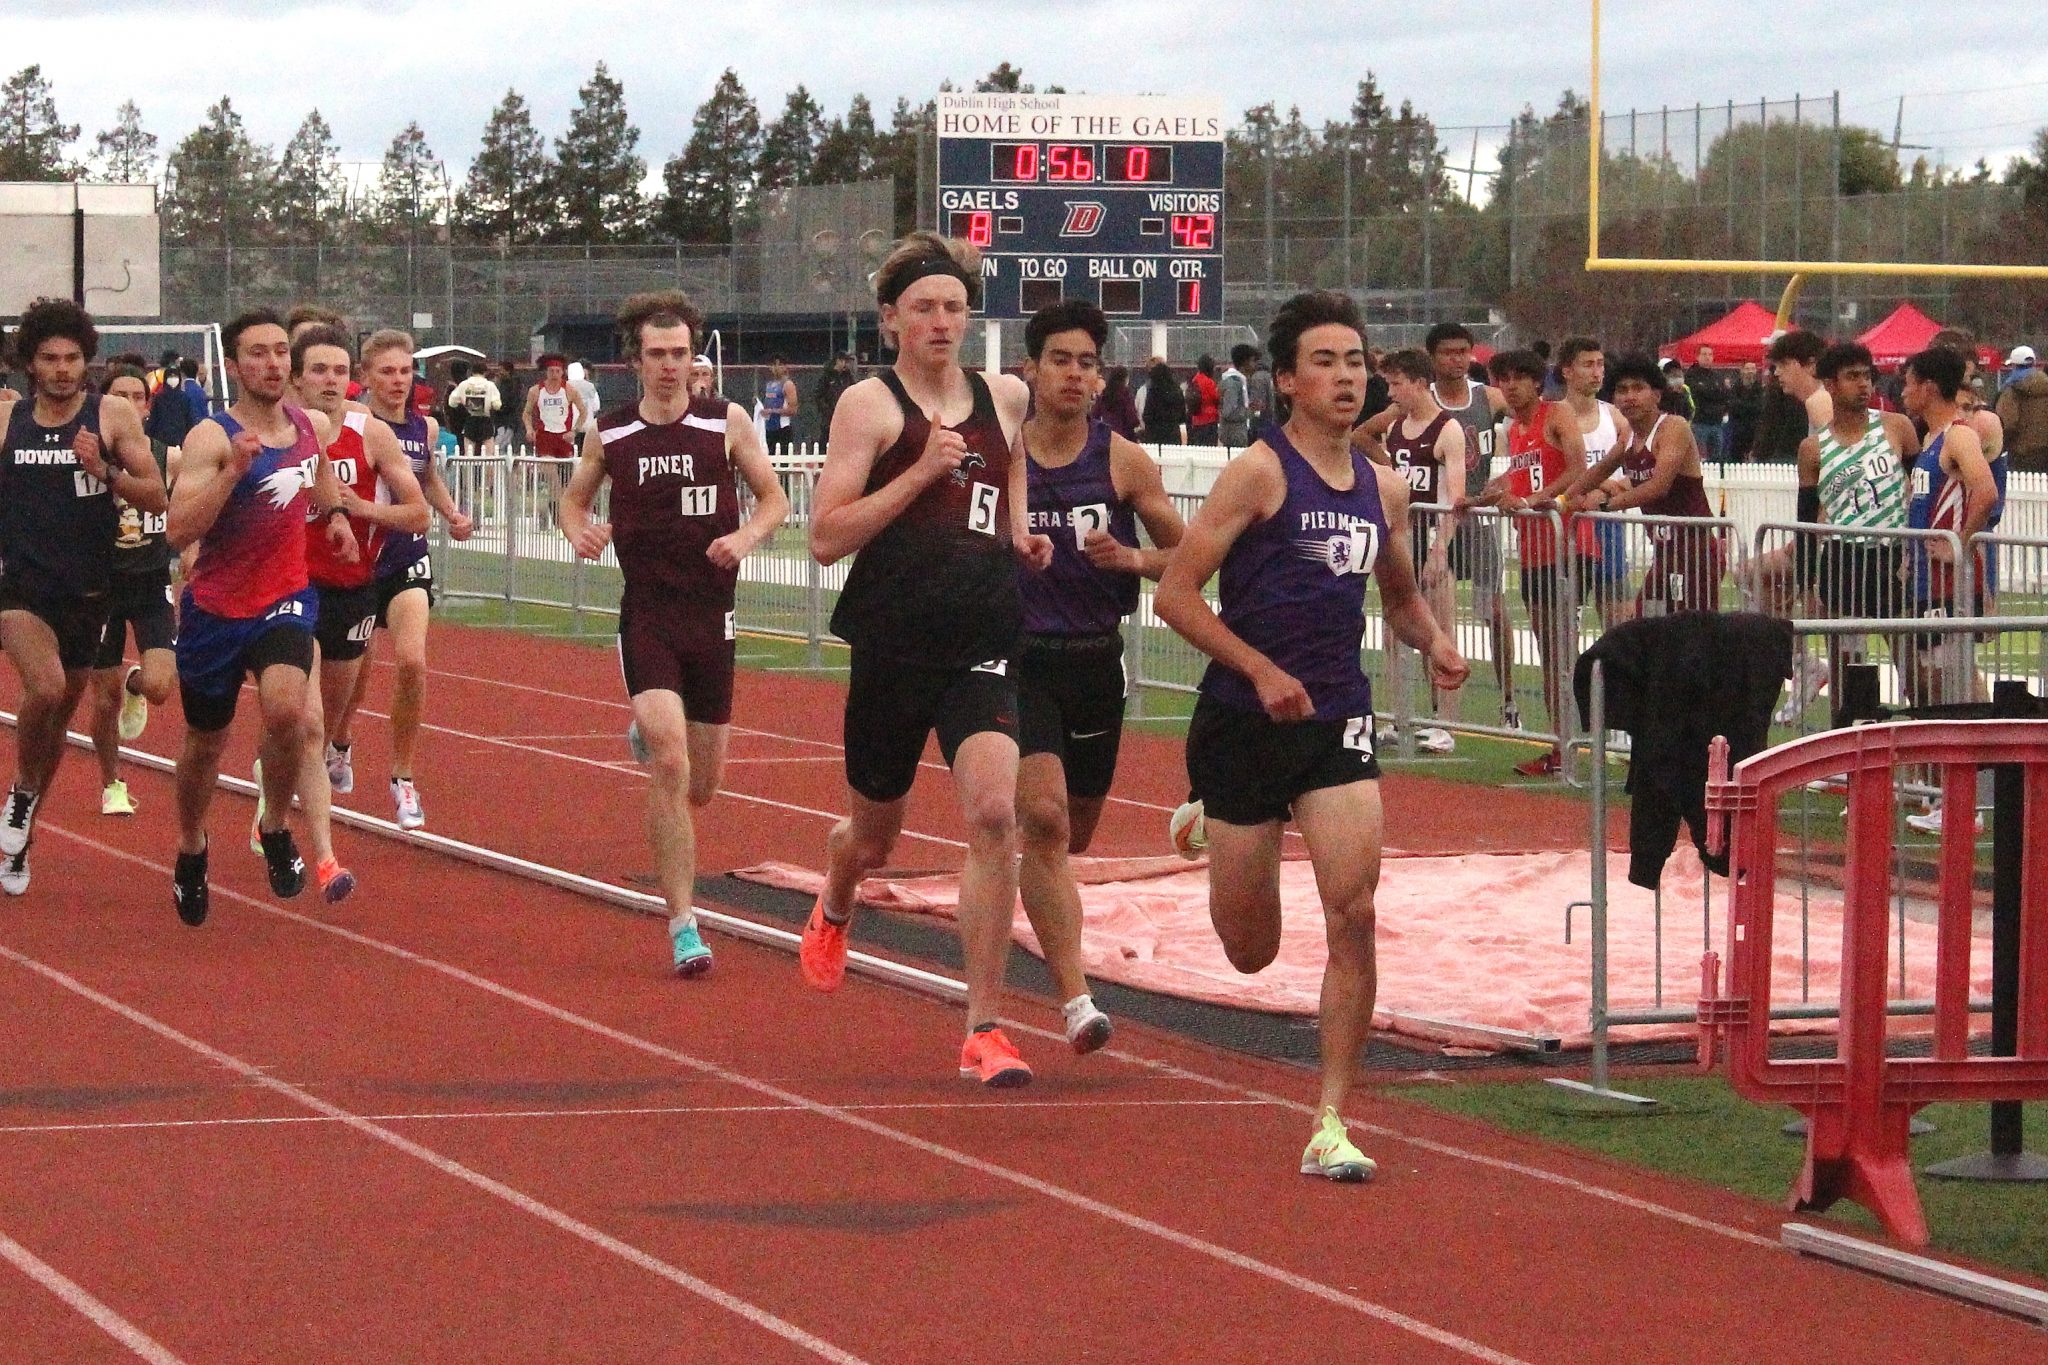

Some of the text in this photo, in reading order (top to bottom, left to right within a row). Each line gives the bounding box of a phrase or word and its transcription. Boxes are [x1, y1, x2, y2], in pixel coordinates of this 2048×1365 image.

[943, 96, 1060, 112] Dublin High School
[943, 113, 1219, 137] HOME OF THE GAELS
[942, 191, 1019, 211] GAELS
[1149, 193, 1220, 213] VISITORS
[1173, 214, 1215, 249] 42
[1018, 259, 1039, 278] TO
[1043, 258, 1068, 278] GO
[1088, 259, 1157, 279] BALL ON
[14, 449, 86, 465] DOWNE
[1868, 455, 1889, 477] 10
[638, 454, 695, 486] PINER
[1532, 468, 1540, 491] 5
[688, 487, 710, 514] 11
[976, 487, 994, 530] 5
[1355, 526, 1372, 570] 7
[356, 618, 374, 640] 10
